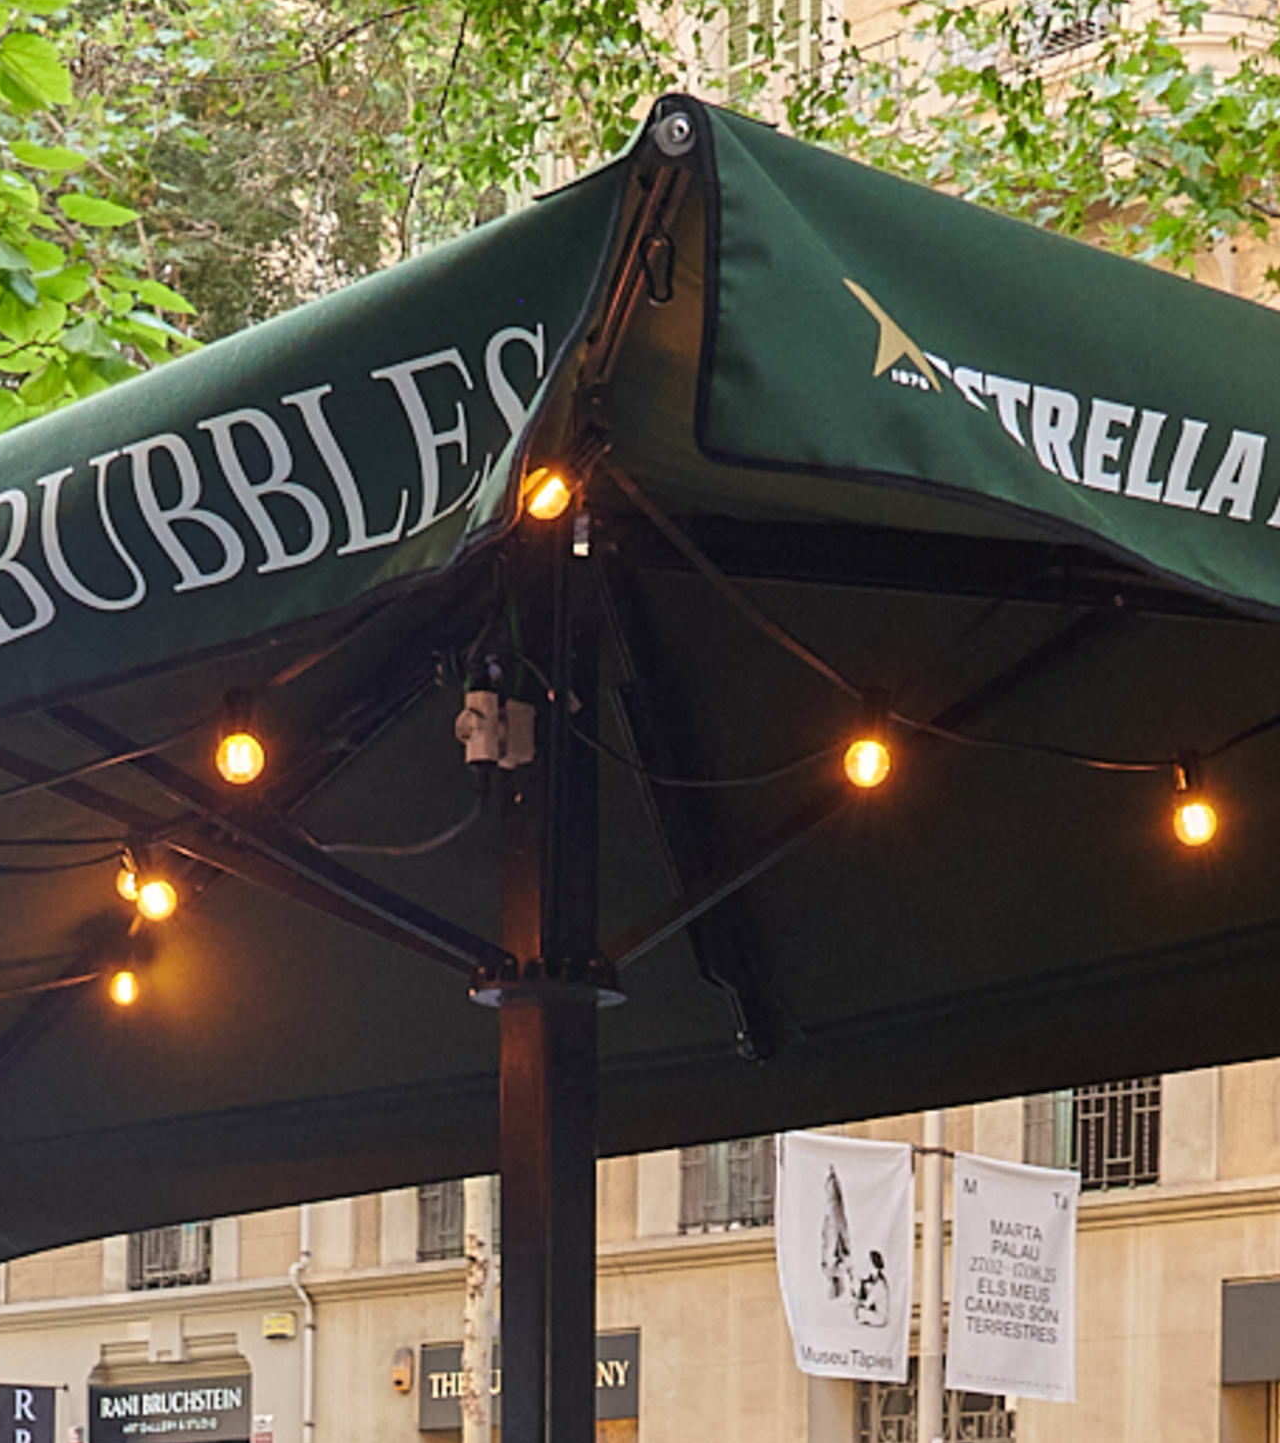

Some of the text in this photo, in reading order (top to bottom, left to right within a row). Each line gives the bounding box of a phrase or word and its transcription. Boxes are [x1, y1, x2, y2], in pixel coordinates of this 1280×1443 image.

[989, 1219, 1043, 1242] MARTA
[991, 1239, 1040, 1261] PALAU
[976, 1276, 1051, 1303] ELS MEUS
[964, 1295, 1026, 1320] CAMINS
[965, 1315, 1058, 1345] TERRESTRES
[15, 1388, 37, 1422] R
[99, 1386, 243, 1419] RANI BRUCHSTEIN
